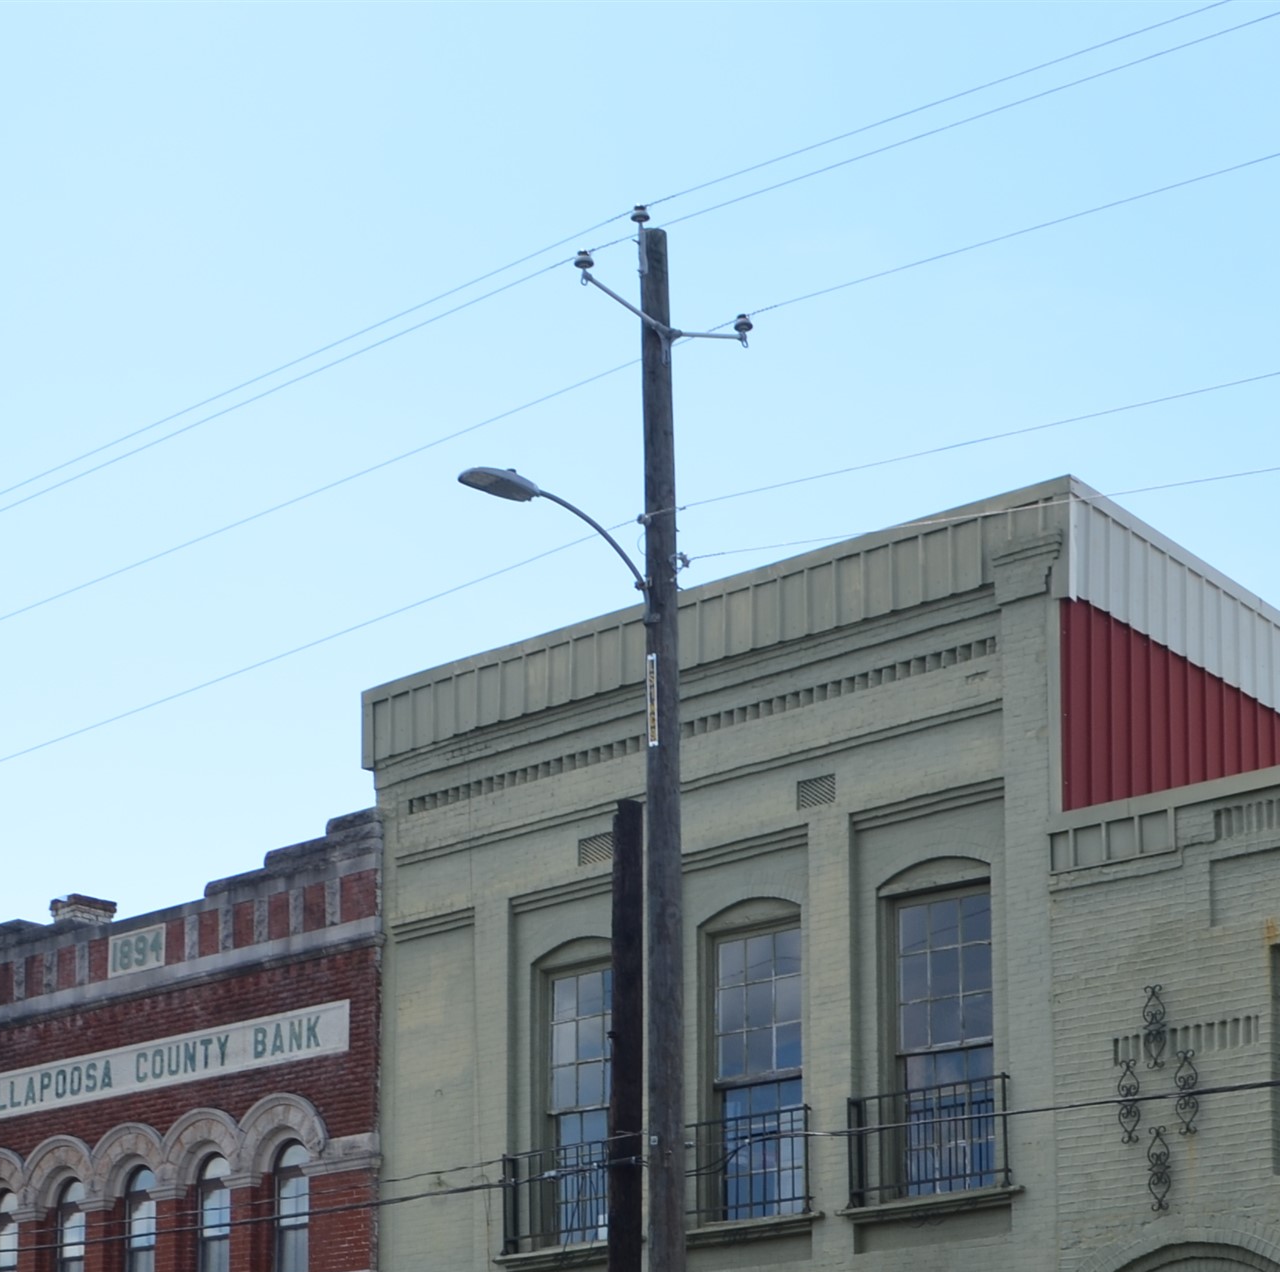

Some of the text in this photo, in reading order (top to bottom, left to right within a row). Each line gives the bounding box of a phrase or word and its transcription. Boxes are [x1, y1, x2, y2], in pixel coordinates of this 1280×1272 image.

[111, 930, 163, 973] 1894
[135, 1034, 230, 1083] COUNTY
[253, 1015, 321, 1060] BANK
